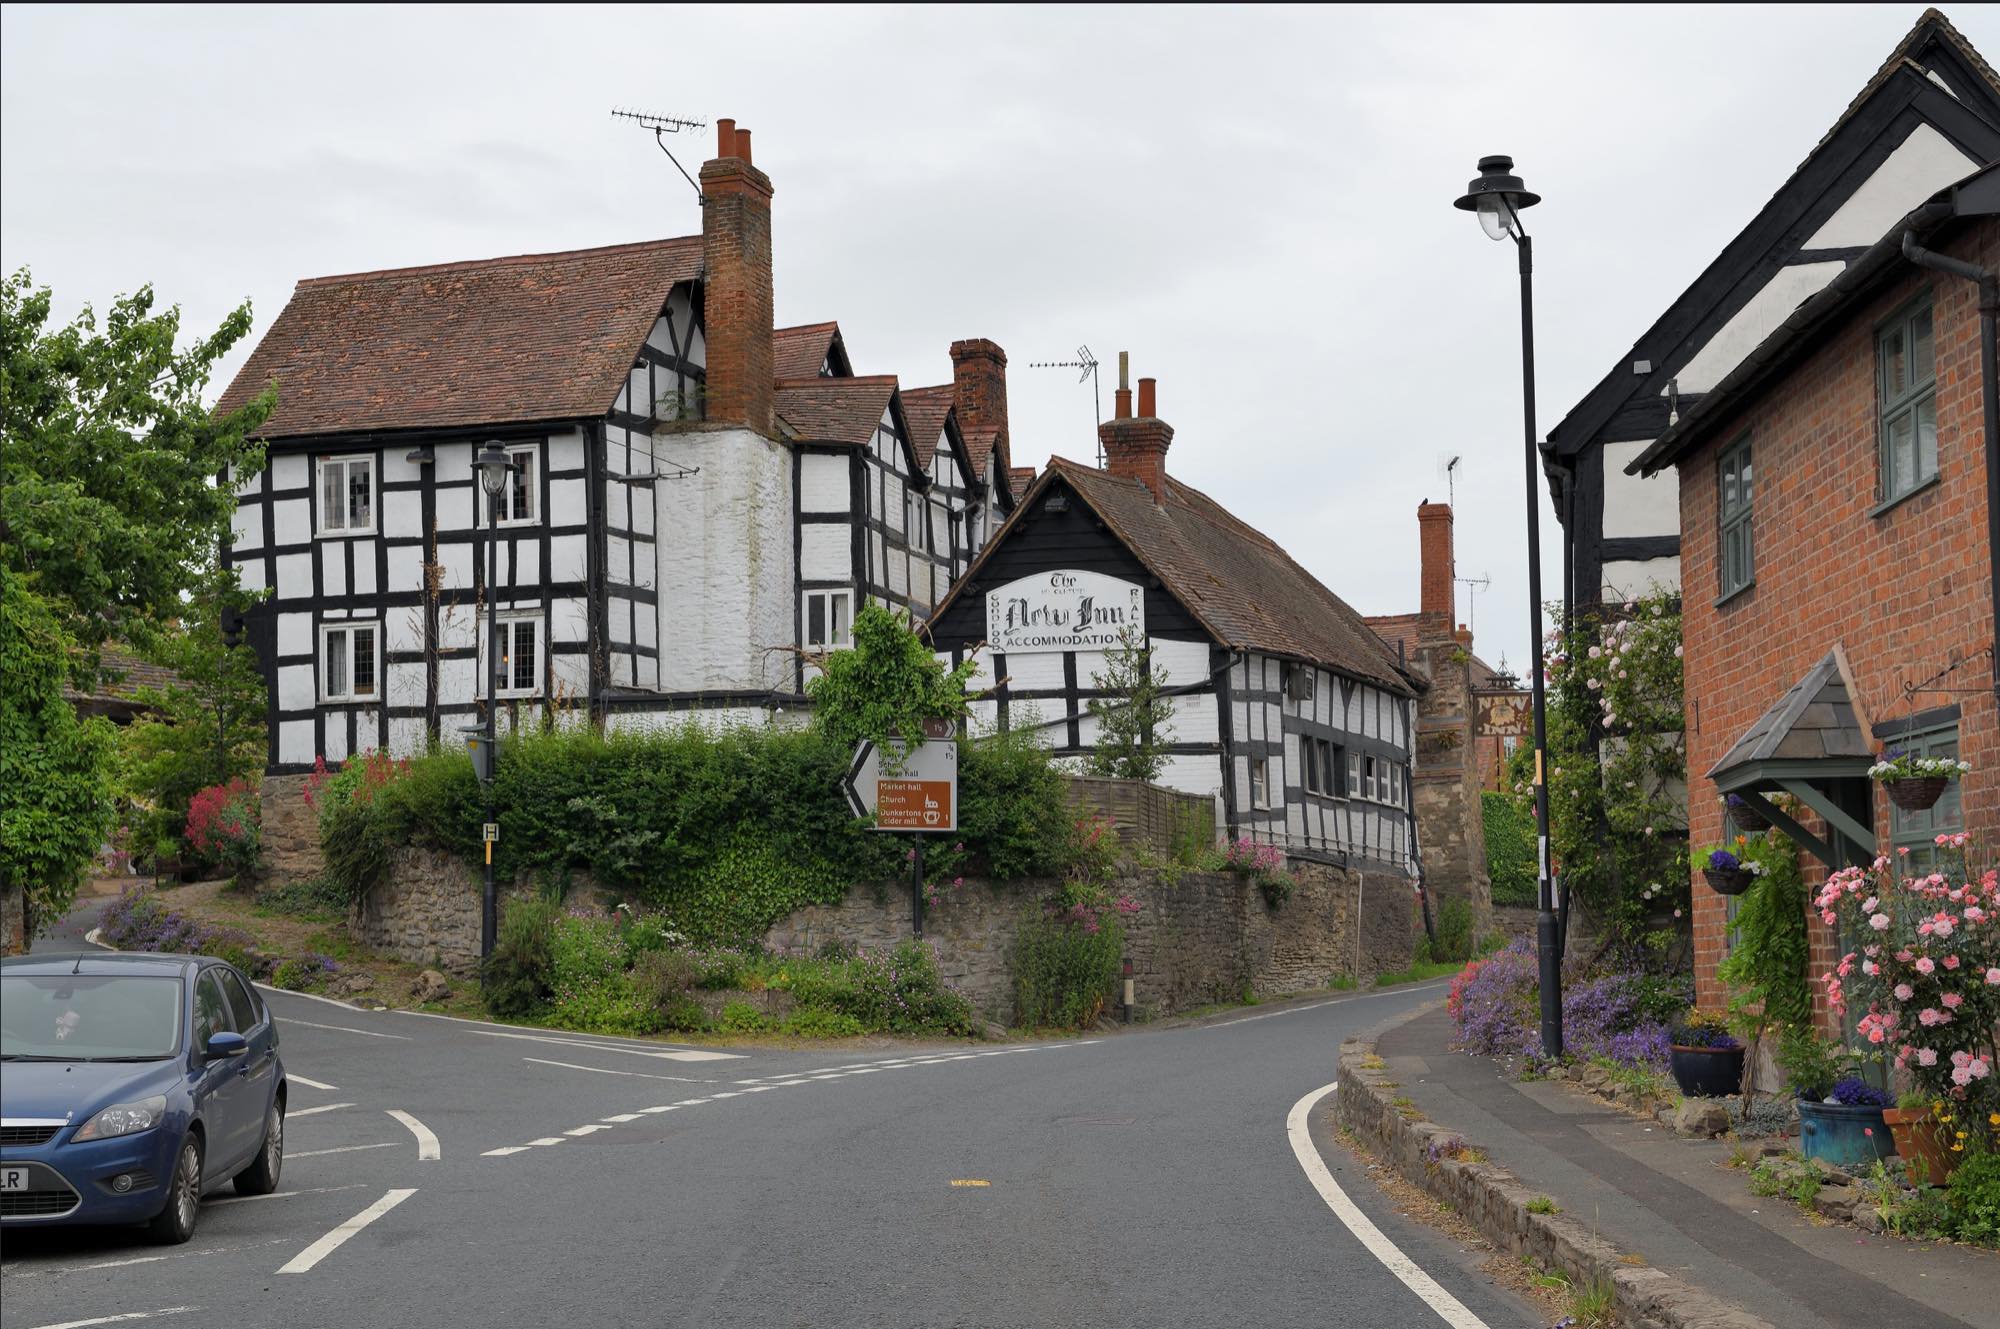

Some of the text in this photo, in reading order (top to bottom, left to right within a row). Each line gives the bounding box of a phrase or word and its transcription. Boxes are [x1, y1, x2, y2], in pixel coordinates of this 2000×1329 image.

[1050, 572, 1077, 588] The
[1003, 595, 1126, 636] New Inn
[1006, 634, 1127, 647] ACCOMMODATION
[1482, 721, 1522, 735] INN
[880, 782, 922, 791] Market hall
[880, 795, 906, 804] Church
[880, 808, 922, 817] Dunkertons
[883, 817, 918, 825] cider mill
